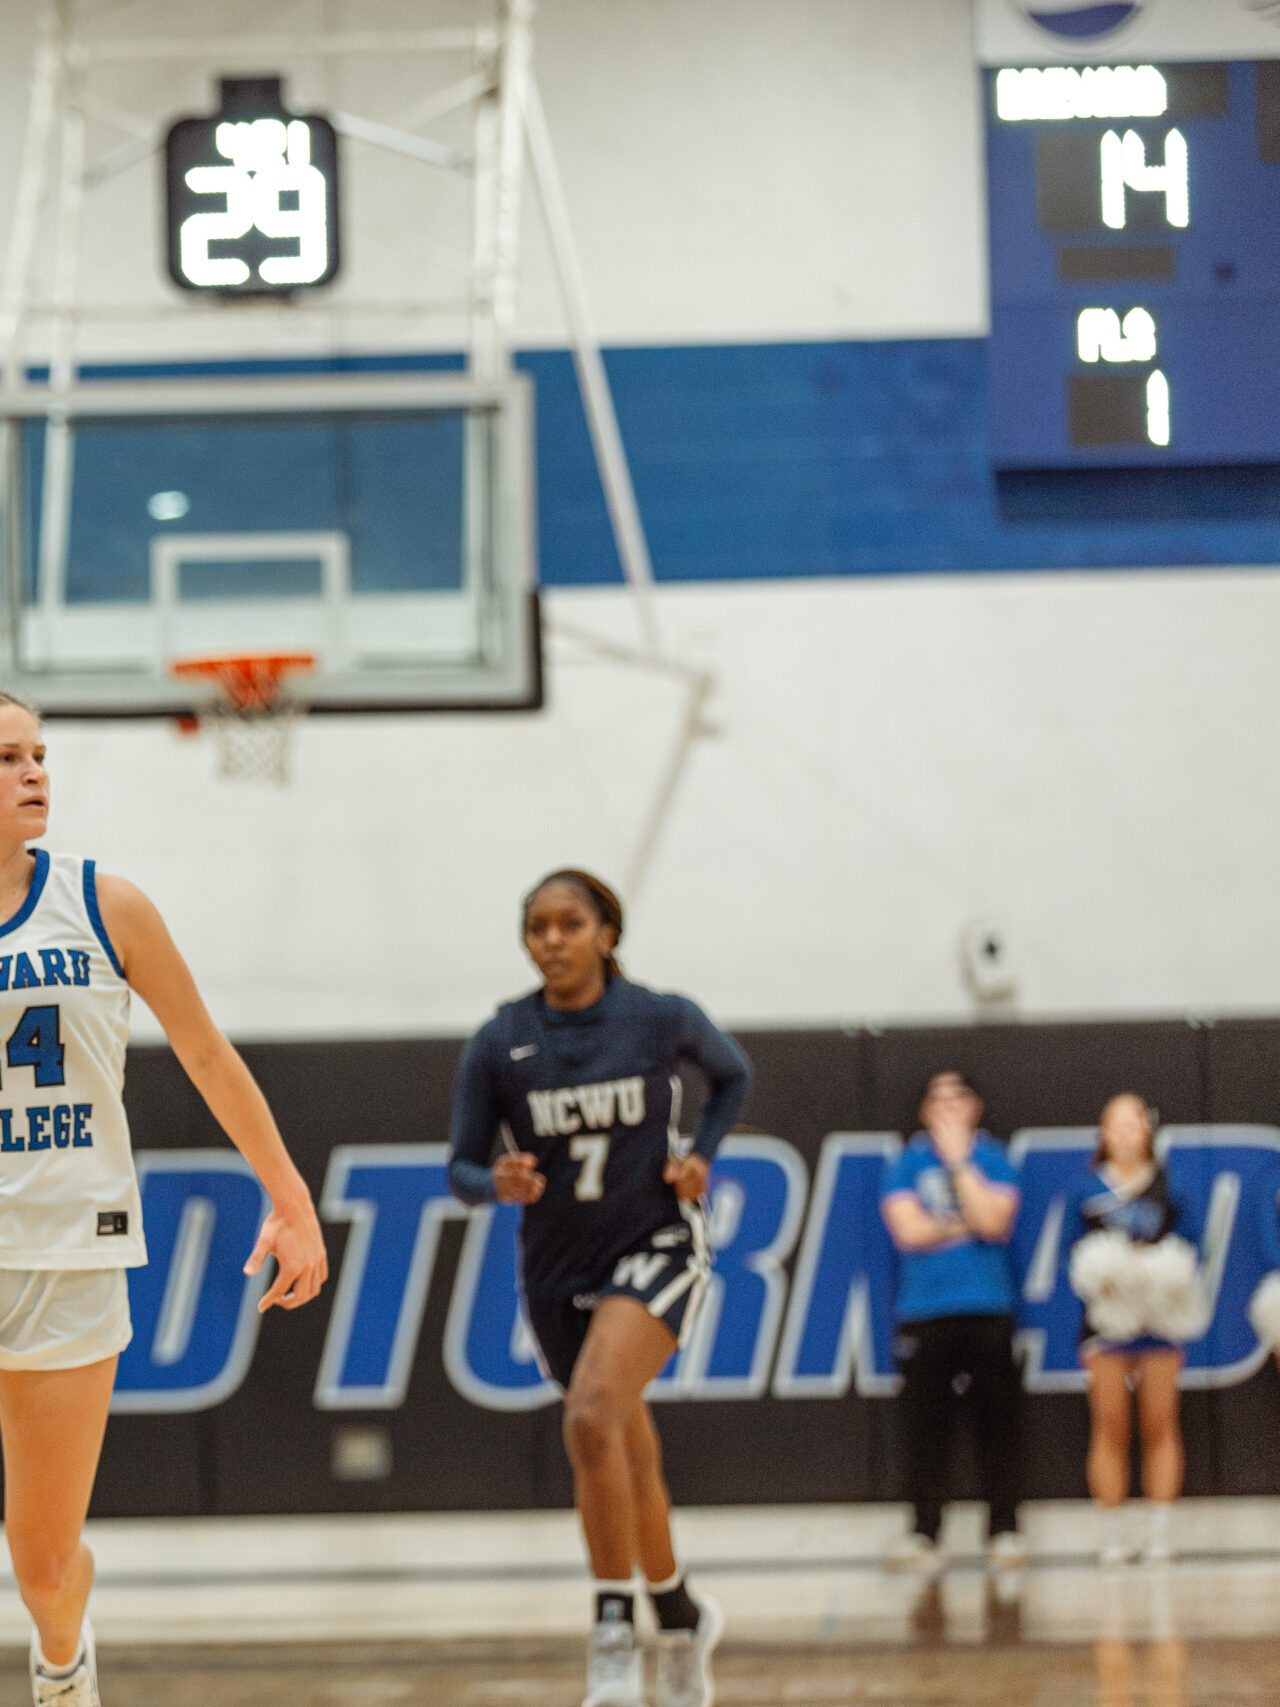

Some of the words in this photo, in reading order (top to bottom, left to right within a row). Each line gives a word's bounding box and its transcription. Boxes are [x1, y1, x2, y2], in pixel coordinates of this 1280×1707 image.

[1100, 127, 1189, 229] 14
[181, 164, 327, 286] 29
[526, 1075, 646, 1137] NCWU
[569, 1134, 611, 1202] 7
